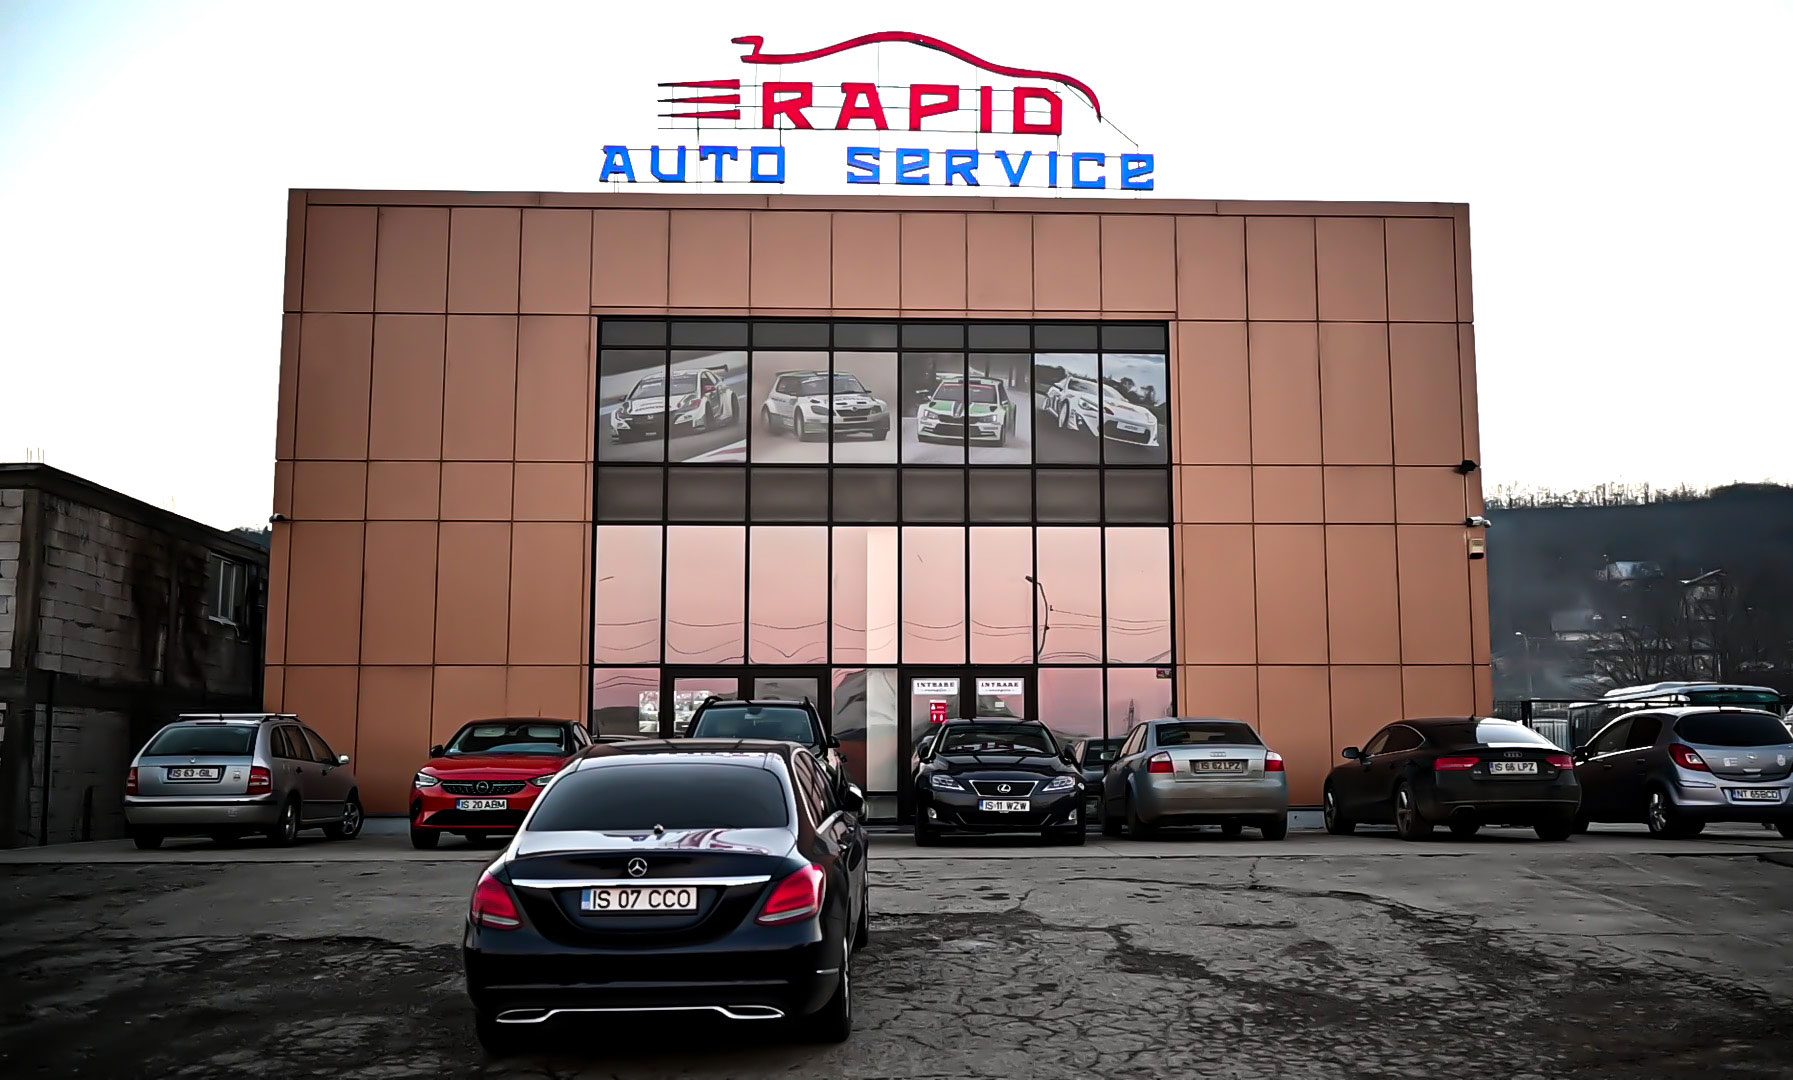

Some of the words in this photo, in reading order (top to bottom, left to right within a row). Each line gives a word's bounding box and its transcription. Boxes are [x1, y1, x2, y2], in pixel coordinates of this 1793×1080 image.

[762, 82, 1063, 136] RAPID
[599, 145, 786, 184] AUTO
[1517, 762, 1535, 772] LPZ
[461, 800, 470, 809] IS
[985, 801, 993, 809] IS
[593, 890, 611, 909] IS
[618, 889, 642, 909] 07
[648, 889, 691, 908] CCO
